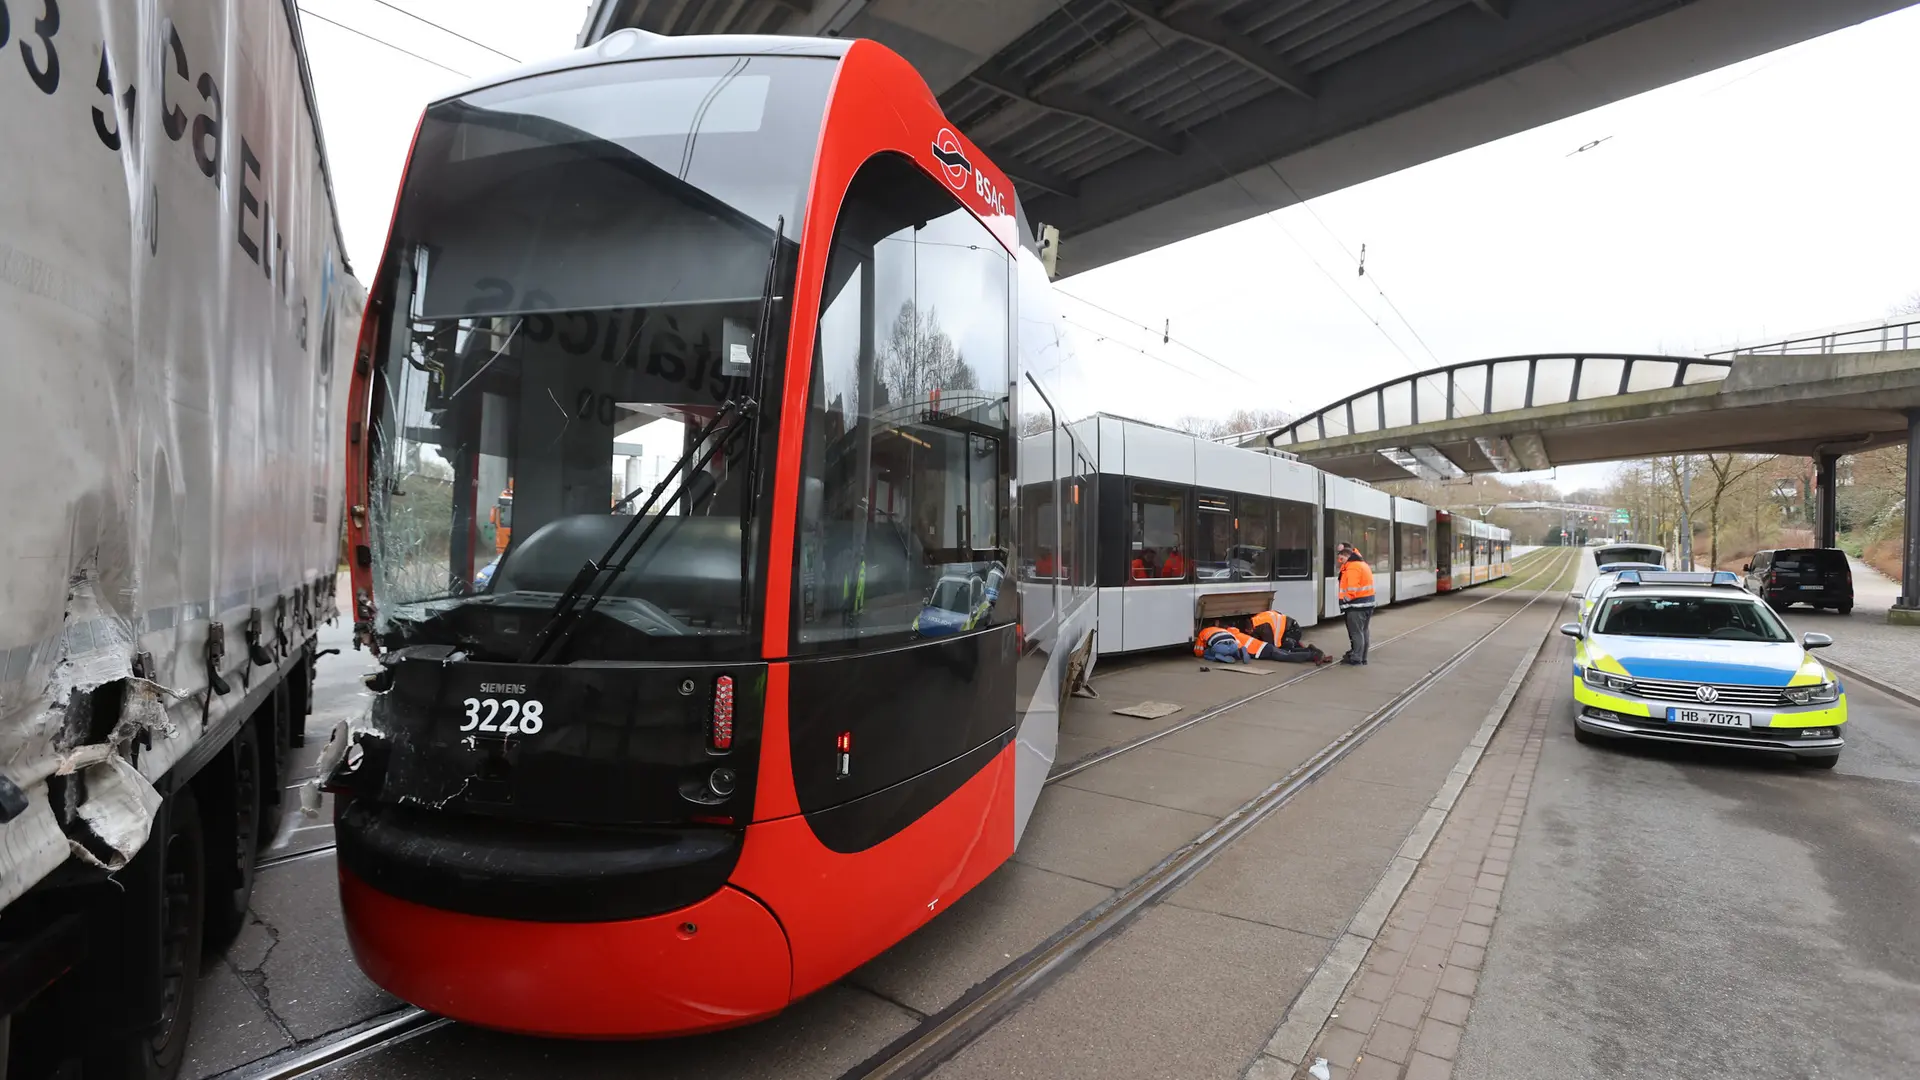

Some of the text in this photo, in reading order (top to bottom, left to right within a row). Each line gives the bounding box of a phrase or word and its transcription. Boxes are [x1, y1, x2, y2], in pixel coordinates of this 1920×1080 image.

[975, 168, 1005, 216] BSAG
[480, 682, 527, 694] SIEMENS
[459, 697, 544, 735] 3228
[1681, 711, 1743, 726] HB 7071
